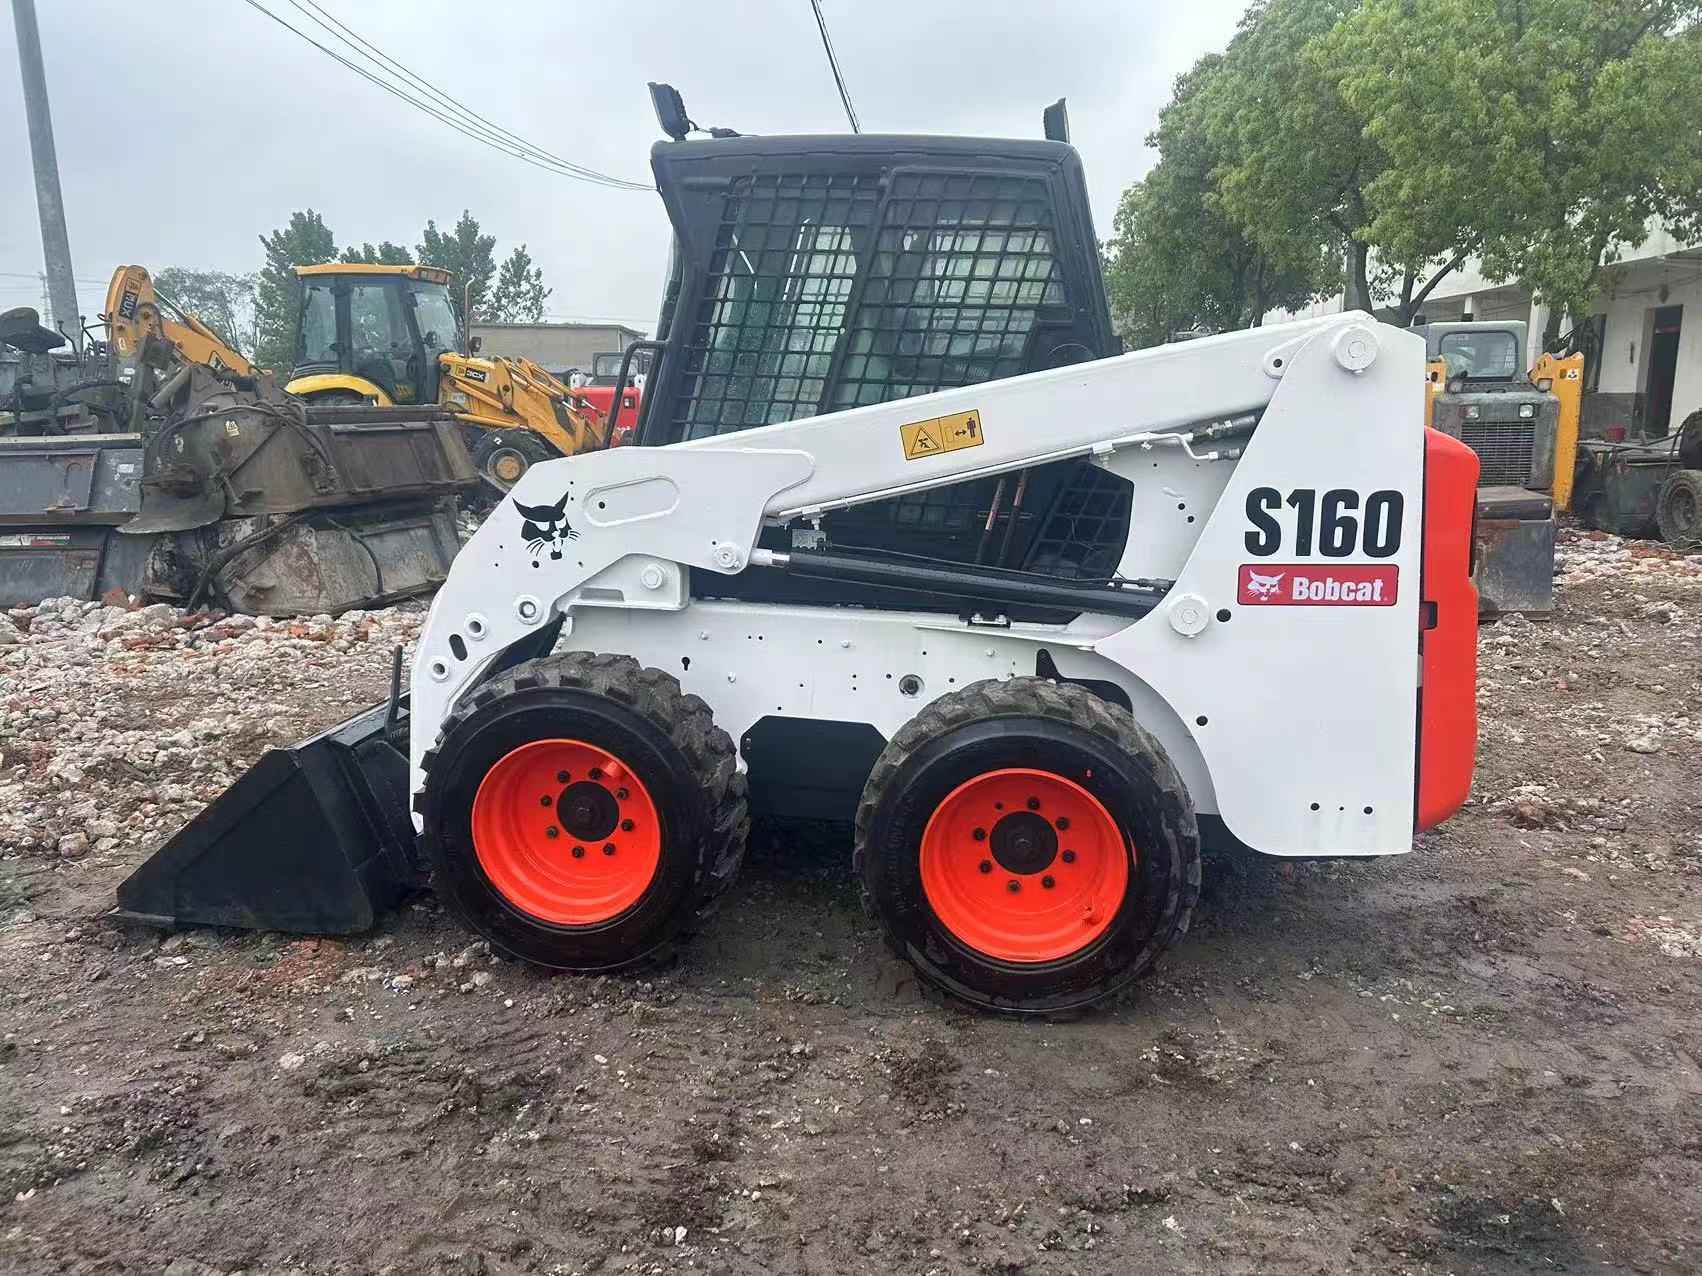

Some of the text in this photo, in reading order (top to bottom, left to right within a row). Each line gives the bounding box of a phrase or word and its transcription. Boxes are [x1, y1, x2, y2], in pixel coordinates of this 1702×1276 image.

[466, 370, 484, 380] 3CX
[1245, 486, 1404, 558] S160
[1292, 576, 1384, 602] Bobcat
